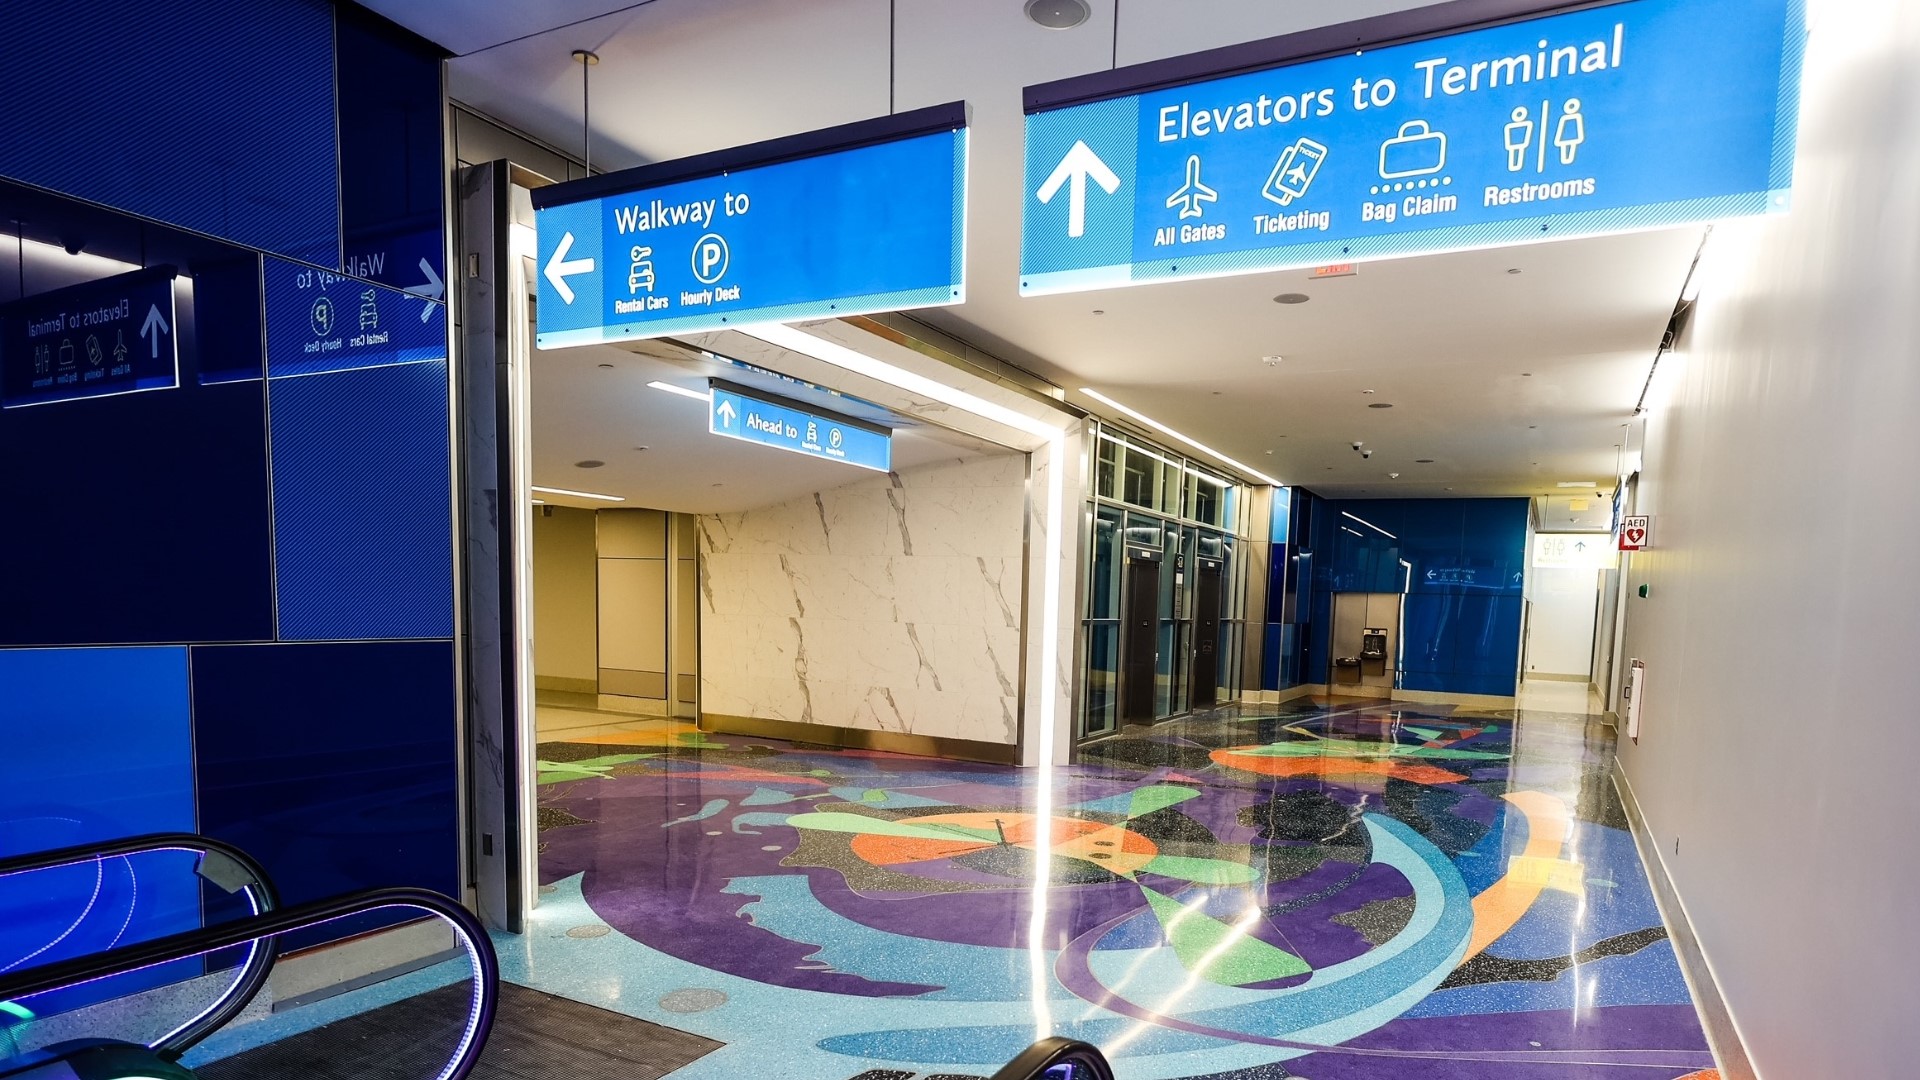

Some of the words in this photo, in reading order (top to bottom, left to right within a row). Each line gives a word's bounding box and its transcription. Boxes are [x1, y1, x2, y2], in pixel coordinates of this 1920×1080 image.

[1157, 88, 1334, 142] Elevators
[1351, 77, 1397, 111] to
[1414, 23, 1624, 99] Terminal
[1483, 177, 1596, 207] Restrooms
[614, 198, 716, 235] Walkway
[723, 191, 750, 217] to
[1361, 201, 1397, 223] Bag
[1402, 193, 1457, 217] Claim
[1153, 227, 1176, 247] All
[1180, 223, 1227, 244] Gates
[1253, 209, 1330, 235] Ticketing
[614, 299, 645, 314] Rental
[646, 295, 669, 310] Cars
[680, 288, 712, 306] Hourly
[715, 284, 741, 301] Deck
[746, 412, 783, 436] Ahead
[786, 424, 798, 439] to
[1627, 518, 1646, 528] AED
